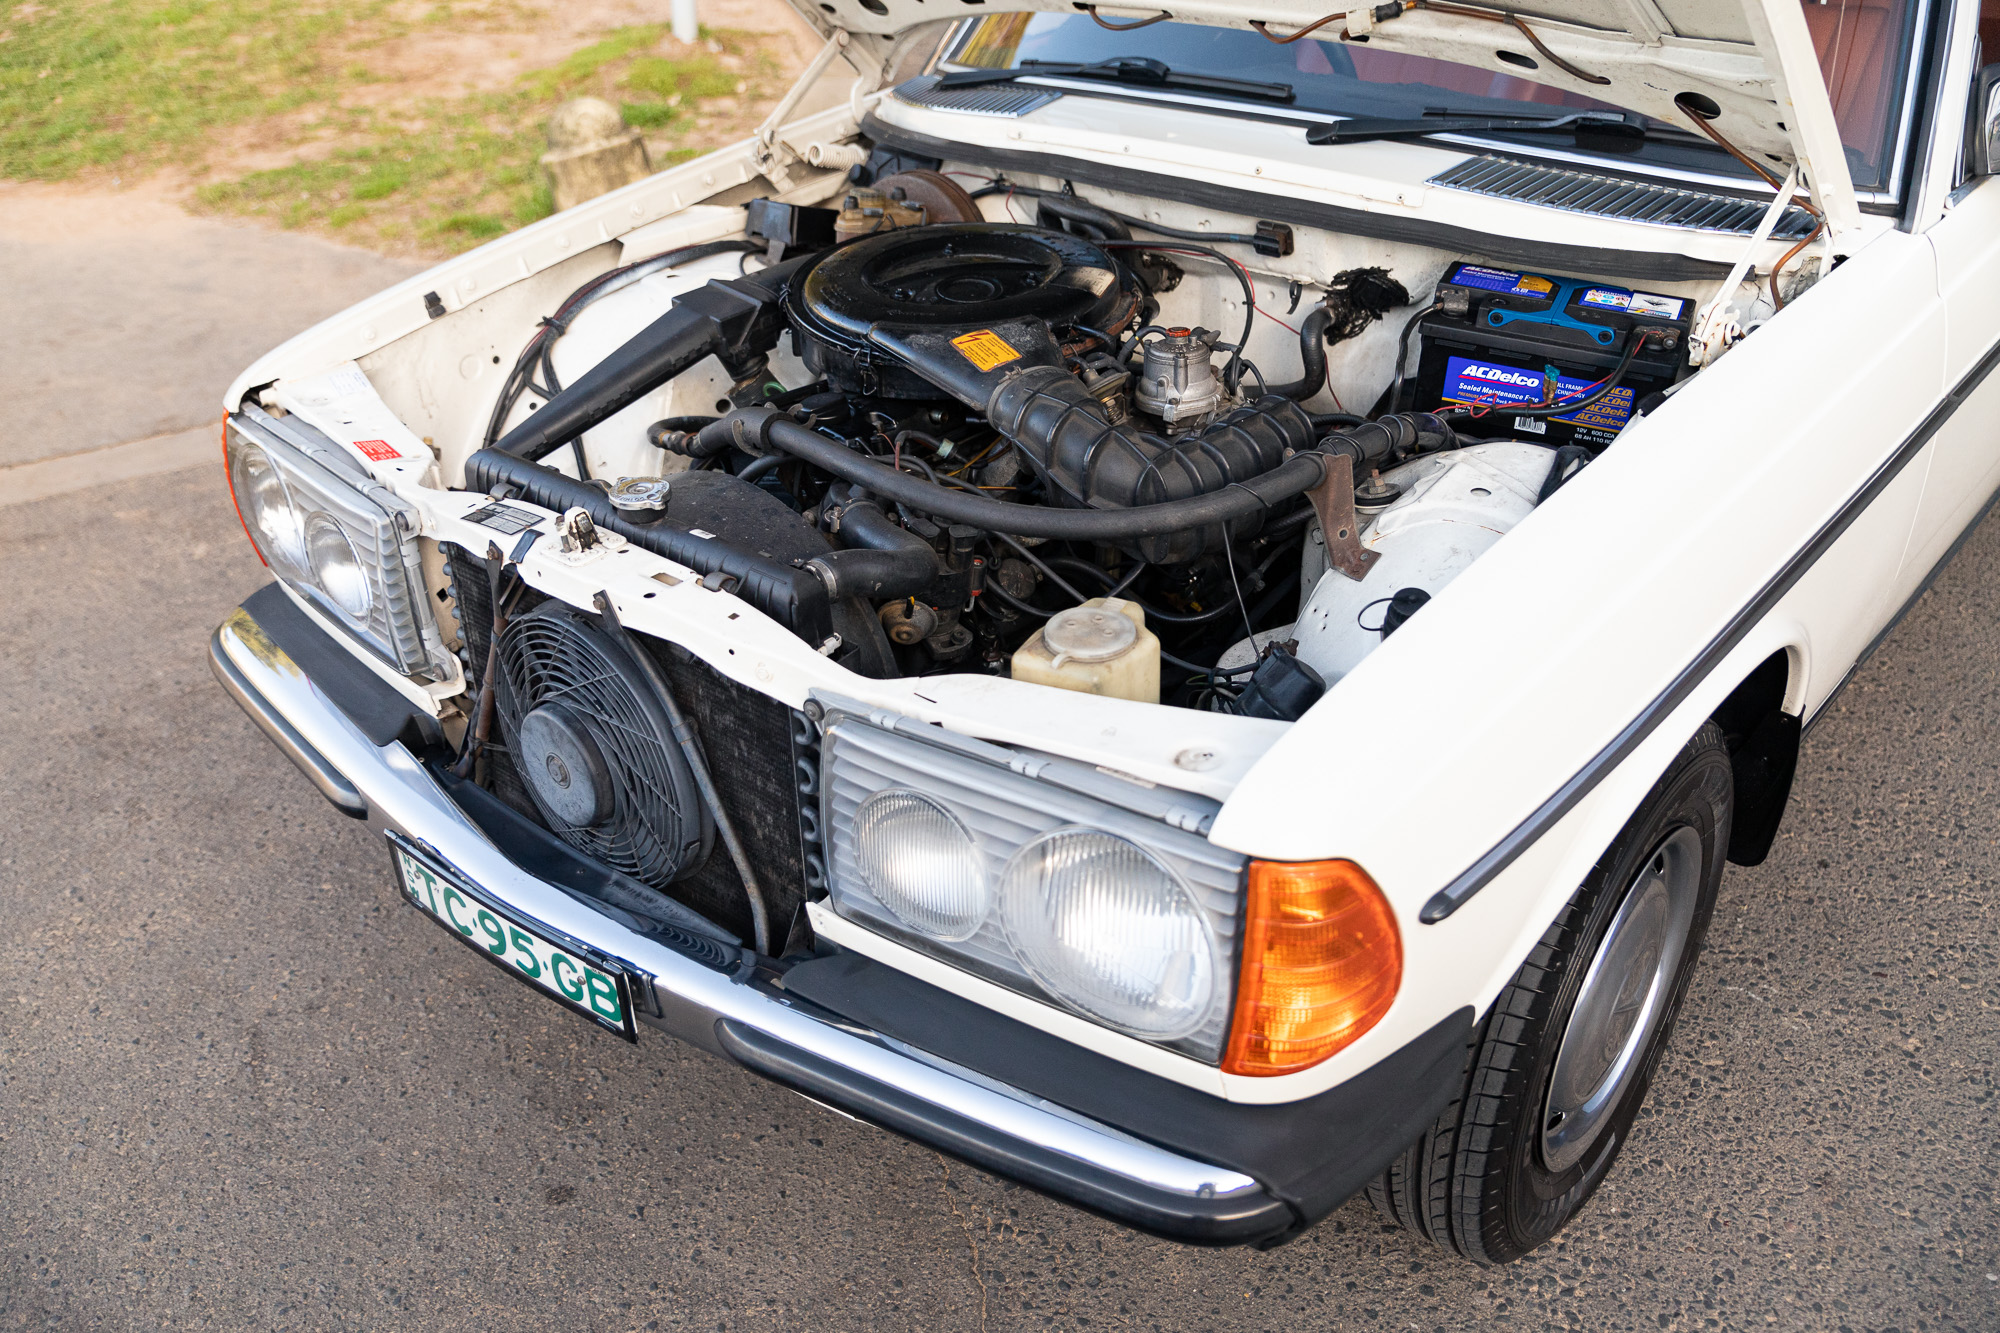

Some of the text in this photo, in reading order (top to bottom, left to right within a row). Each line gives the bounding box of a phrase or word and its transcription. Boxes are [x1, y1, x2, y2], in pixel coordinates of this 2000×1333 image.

[1462, 364, 1540, 388] ACDelco
[1458, 382, 1481, 392] Sealed
[1481, 386, 1524, 401] Maintenance
[1575, 412, 1626, 427] ACDelco
